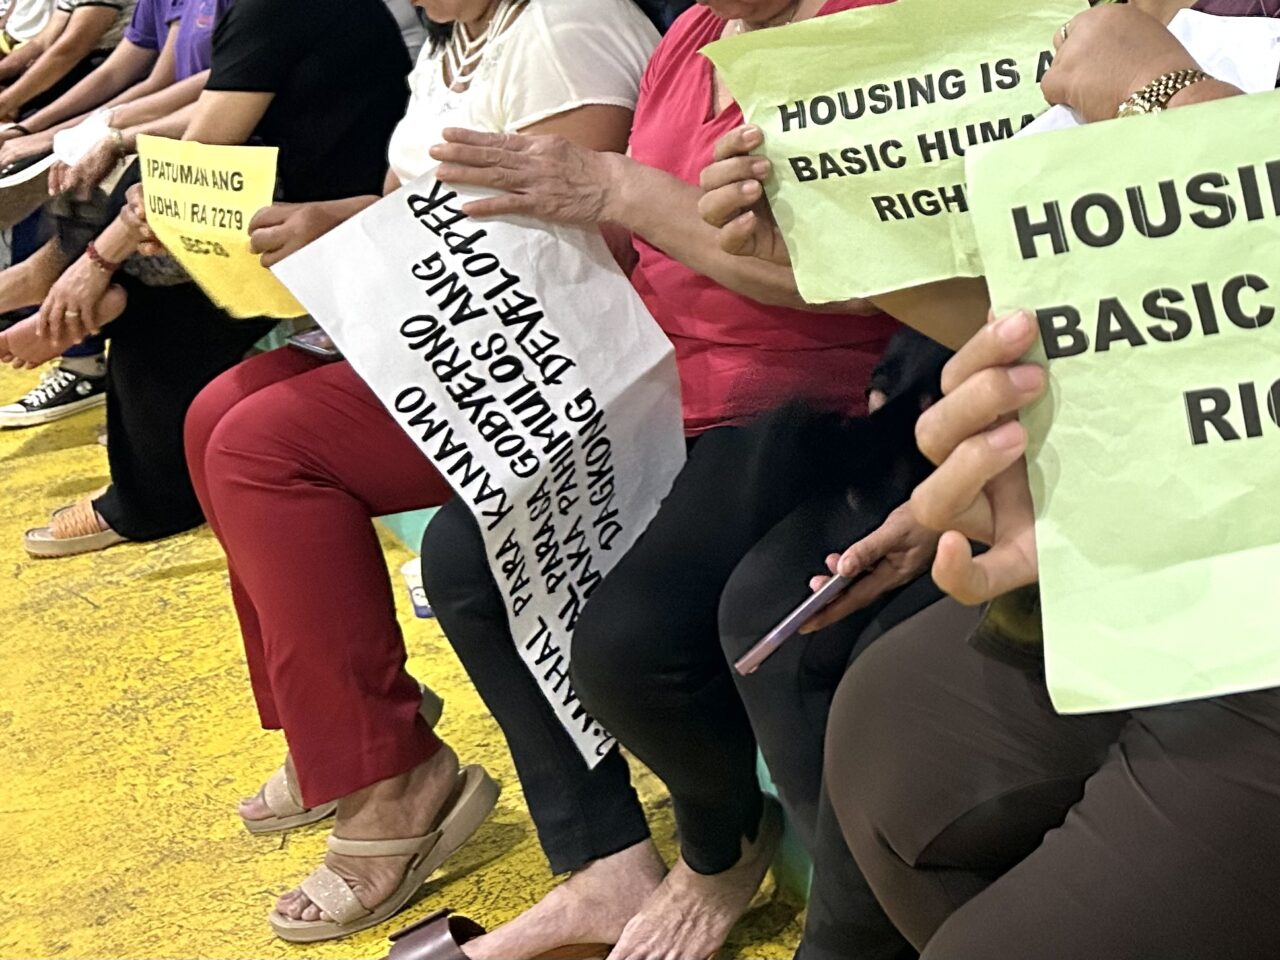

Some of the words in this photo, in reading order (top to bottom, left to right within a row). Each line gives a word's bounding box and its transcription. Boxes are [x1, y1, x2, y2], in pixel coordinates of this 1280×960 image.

[777, 68, 967, 133] HOUSING
[979, 57, 1021, 94] IS
[1035, 49, 1055, 84] A
[146, 158, 210, 188] IPATUMAN
[211, 170, 245, 192] ANG
[788, 138, 907, 183] BASIC
[871, 183, 970, 222] RIGH
[148, 194, 181, 220] UDHA
[190, 203, 208, 225] RA
[211, 207, 244, 231] 7279
[407, 180, 577, 386] DEVELOPER
[411, 251, 489, 326] ANG
[1034, 273, 1276, 360] BASIC
[399, 314, 540, 478] GOBYERNO
[470, 332, 579, 516] PAHIMULOS
[394, 386, 515, 531] KANAMO
[564, 387, 623, 551] DAGKONG
[495, 527, 533, 617] PARA
